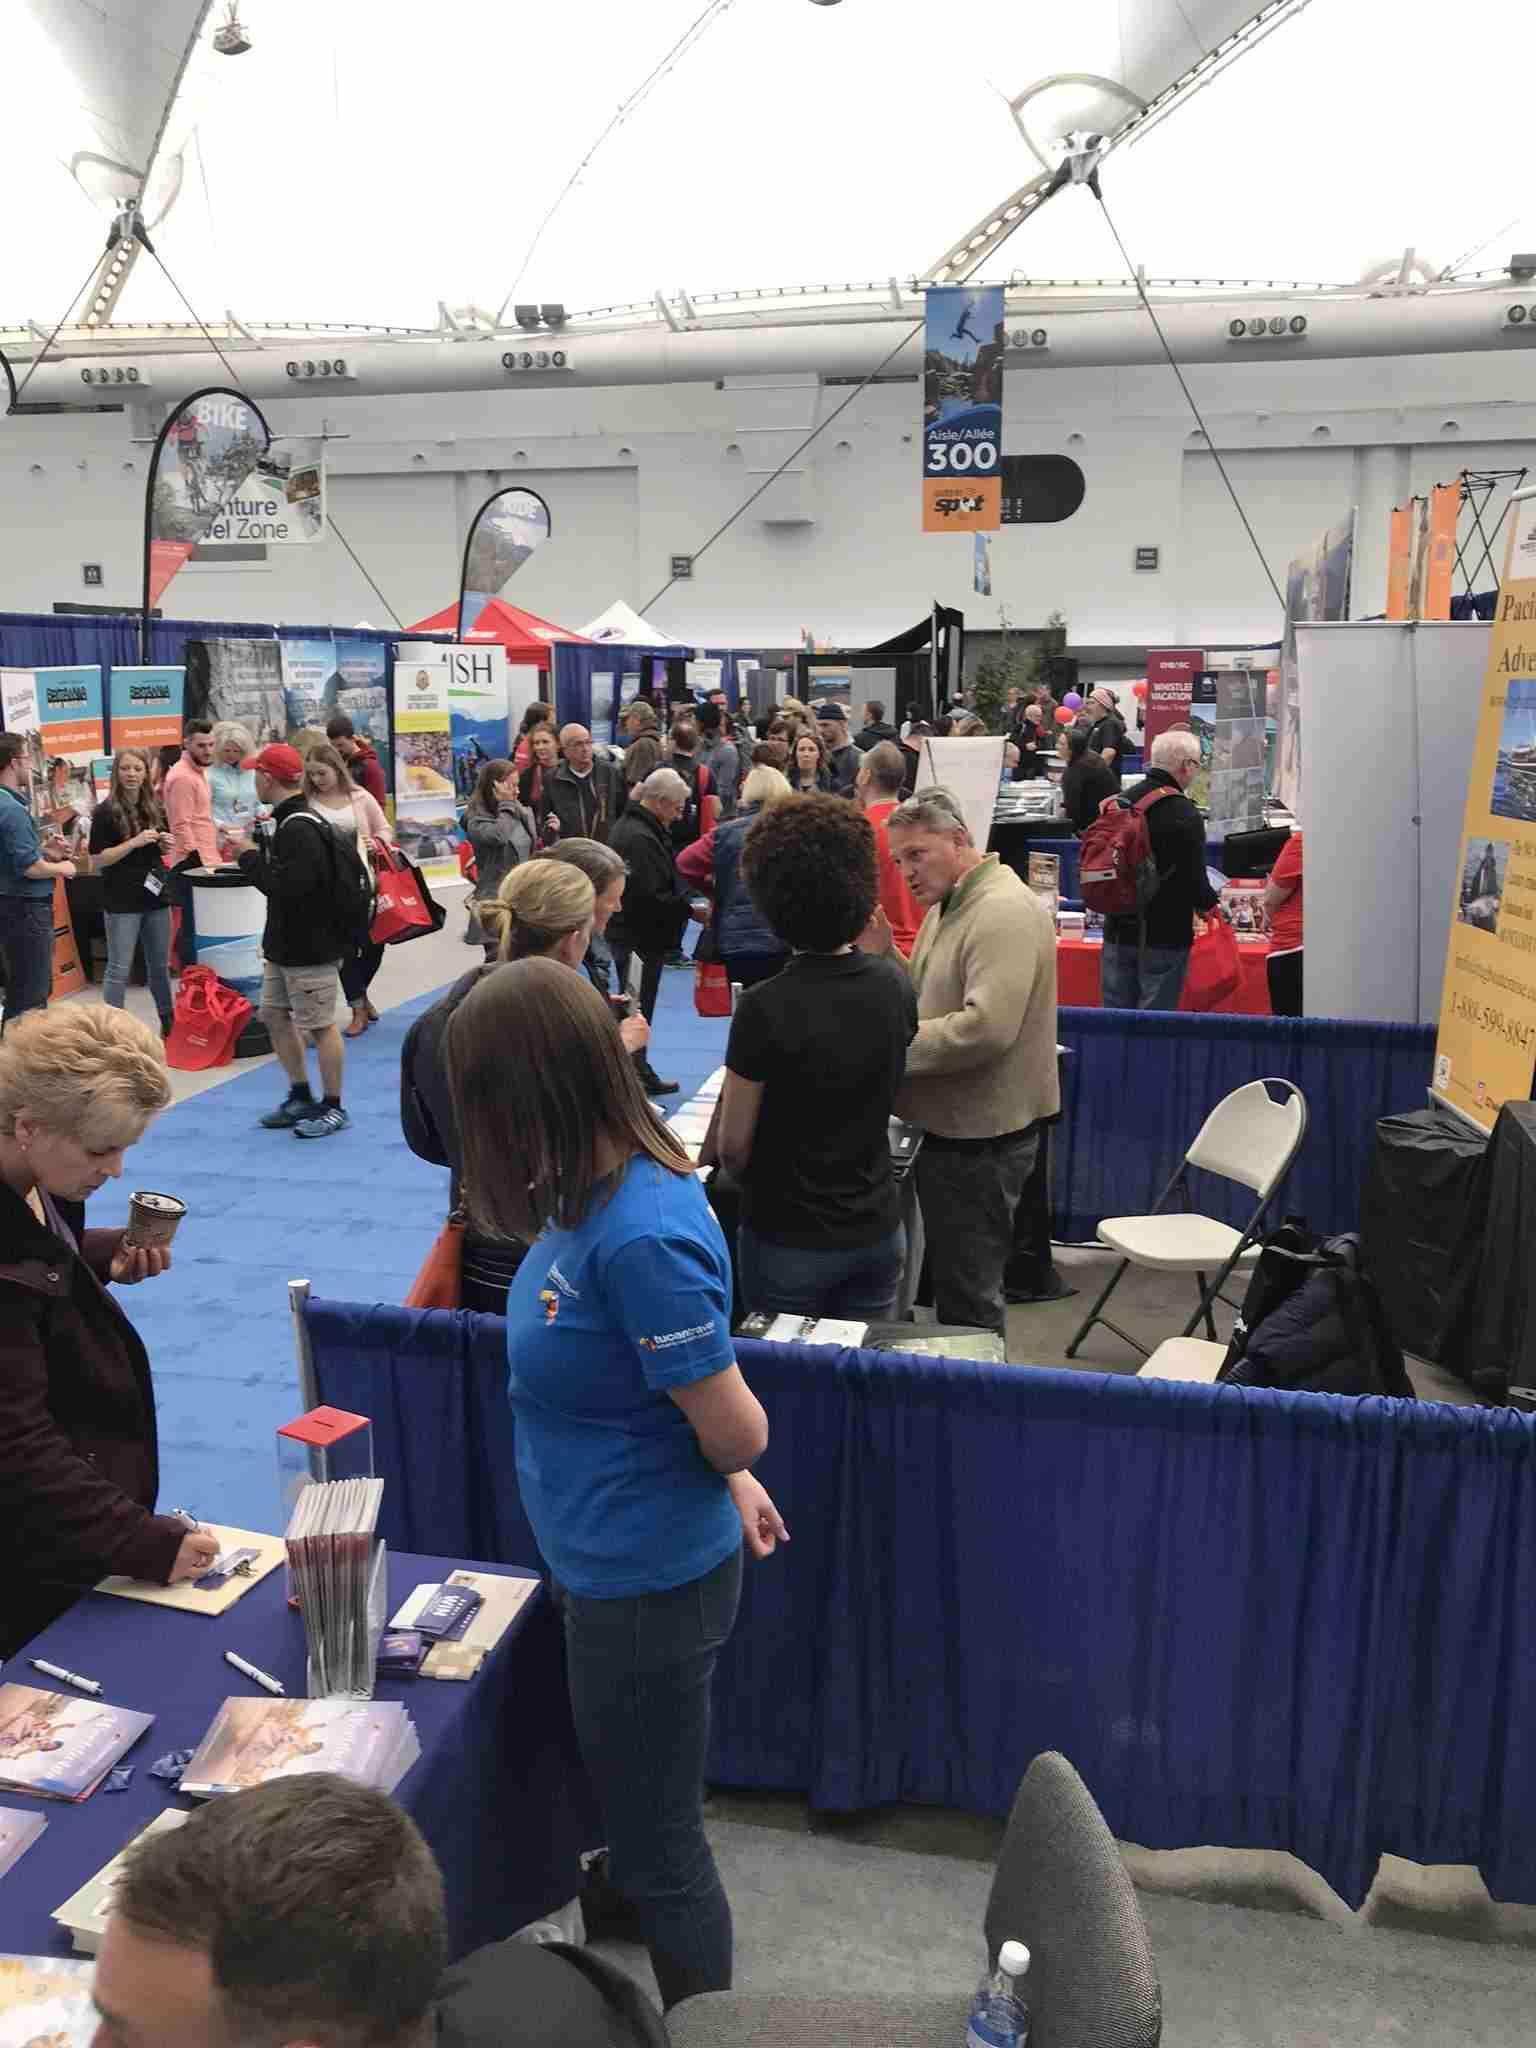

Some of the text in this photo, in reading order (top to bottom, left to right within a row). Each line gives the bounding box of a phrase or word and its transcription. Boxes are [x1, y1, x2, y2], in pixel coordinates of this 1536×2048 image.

[197, 402, 249, 430] BIKE
[927, 428, 995, 441] Aisle/Allée
[927, 441, 998, 471] 300
[236, 518, 289, 539] Zone
